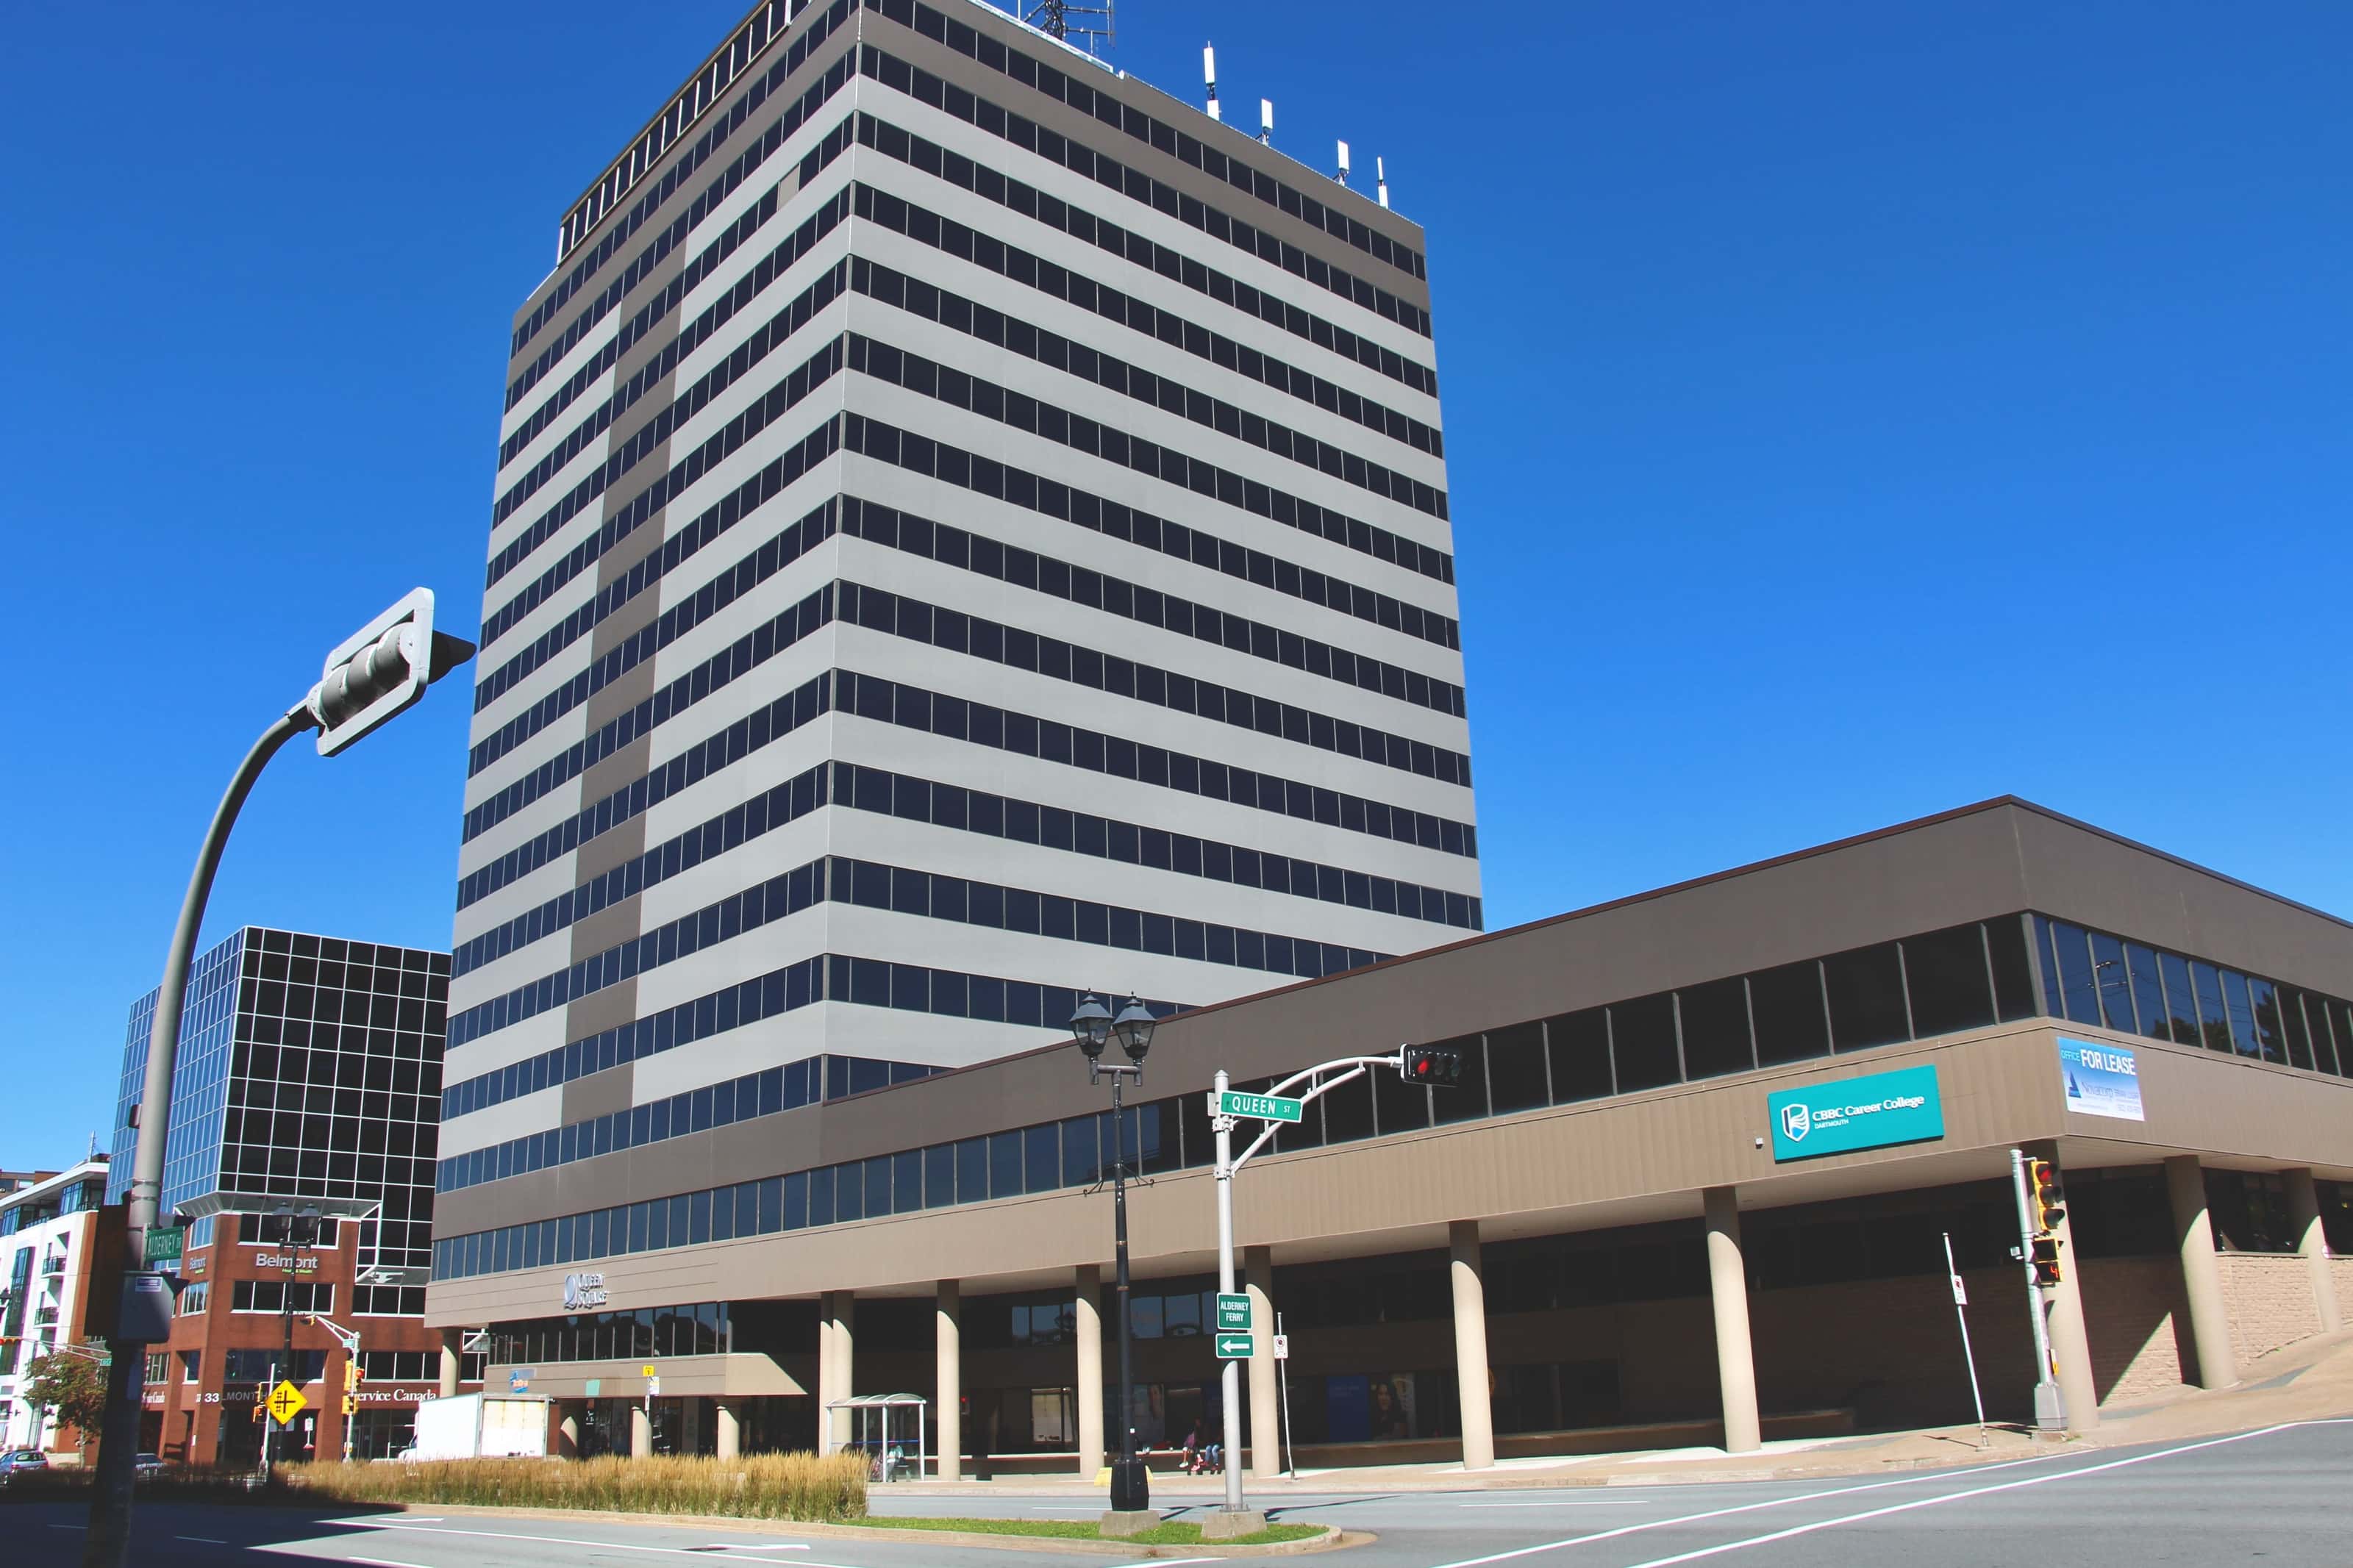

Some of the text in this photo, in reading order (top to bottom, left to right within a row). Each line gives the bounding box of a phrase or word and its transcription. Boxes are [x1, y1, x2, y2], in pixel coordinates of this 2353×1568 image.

[2060, 1049, 2136, 1075] OFFICE FOR LEASE
[1232, 1095, 1290, 1114] QUEEN ST
[1812, 1096, 1924, 1122] CBBC Career College
[1814, 1118, 1849, 1130] DARTMOUTH
[256, 1253, 318, 1269] Belmont
[2049, 1266, 2058, 1278] 4
[576, 1272, 605, 1292] QUEEN
[1221, 1301, 1249, 1311] ALDERNEY
[1226, 1312, 1244, 1322] FERRY
[204, 1393, 220, 1403] 33
[355, 1389, 437, 1401] ervice Canada
